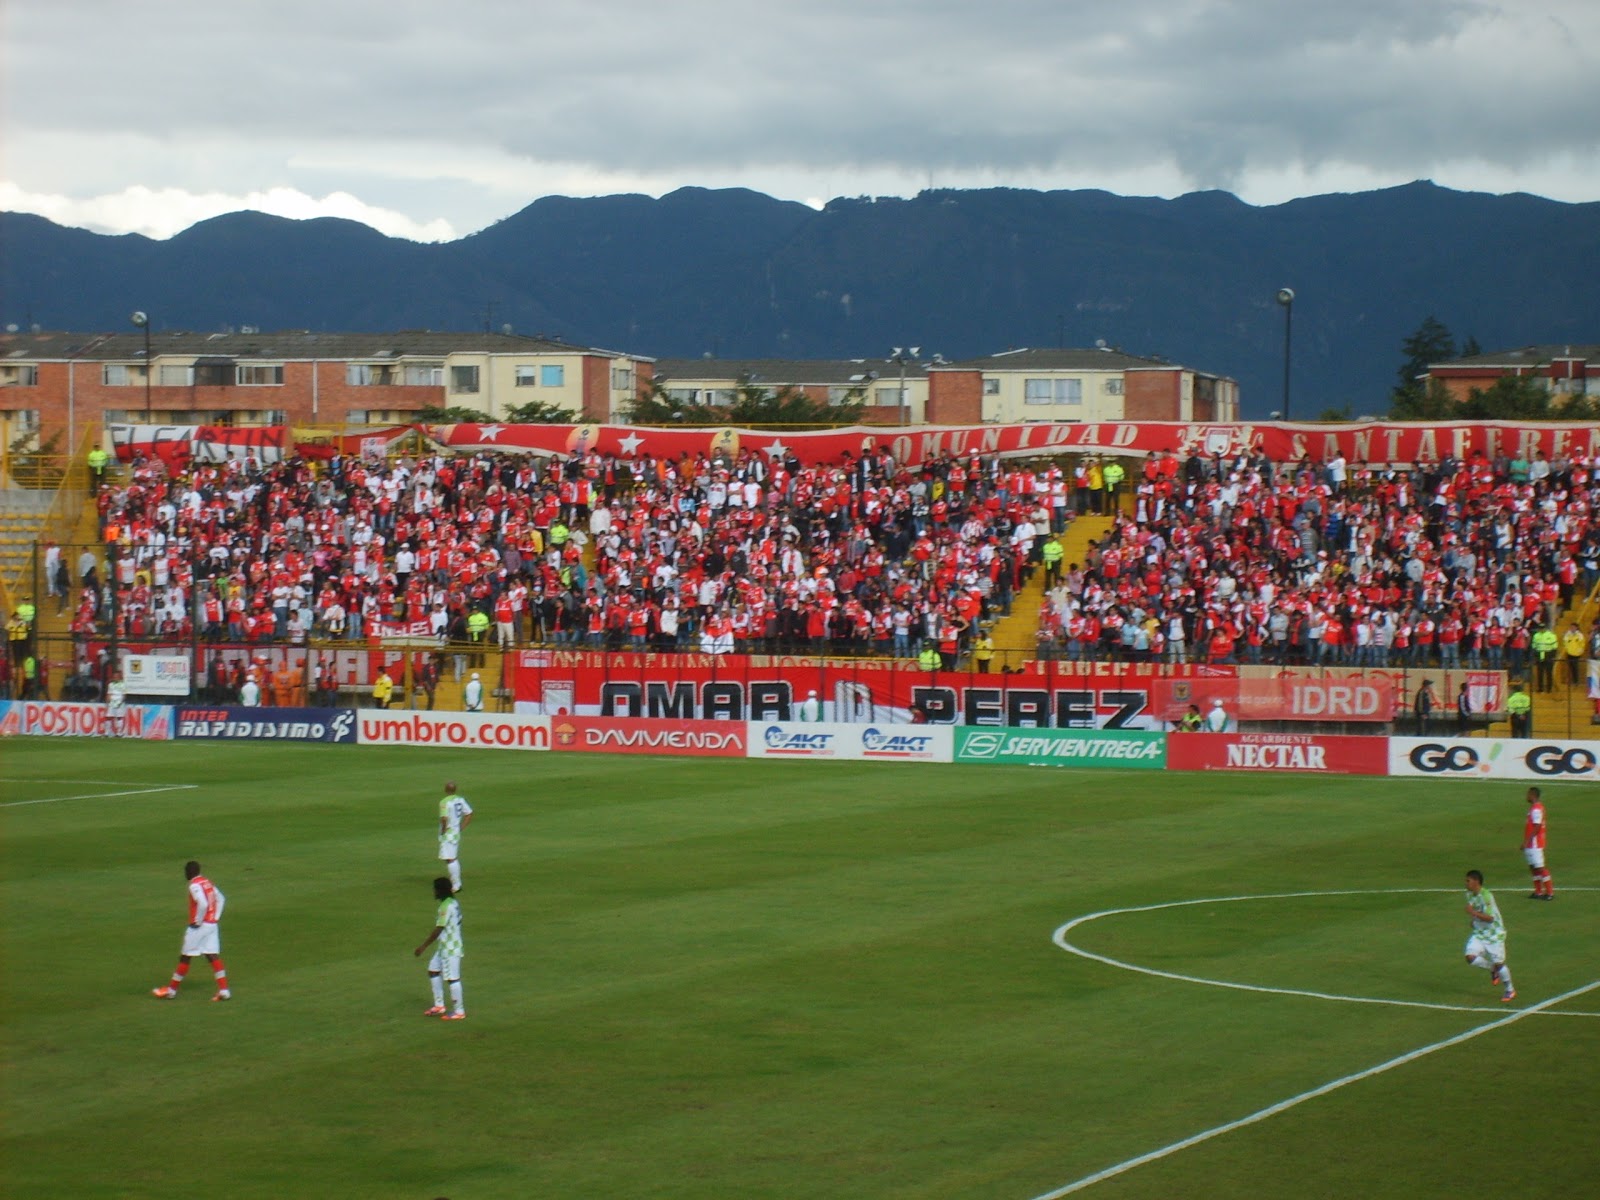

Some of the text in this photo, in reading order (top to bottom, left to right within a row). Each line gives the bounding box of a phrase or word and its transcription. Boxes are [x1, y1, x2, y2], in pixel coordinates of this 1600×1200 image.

[601, 680, 794, 722] OMAR
[911, 685, 1148, 731] PEREZ
[1292, 685, 1379, 715] IDRD
[180, 710, 229, 722] INTER
[179, 721, 325, 739] RAPIDISIMO
[363, 714, 548, 747] umbro.com
[584, 729, 743, 750] DAVIVIENDA
[1240, 735, 1313, 745] AGUARDIENTE
[783, 734, 834, 749] AKT
[880, 736, 932, 751] AKT
[1000, 737, 1162, 760] SERVIENTREGA
[1227, 744, 1327, 769] NECTAR
